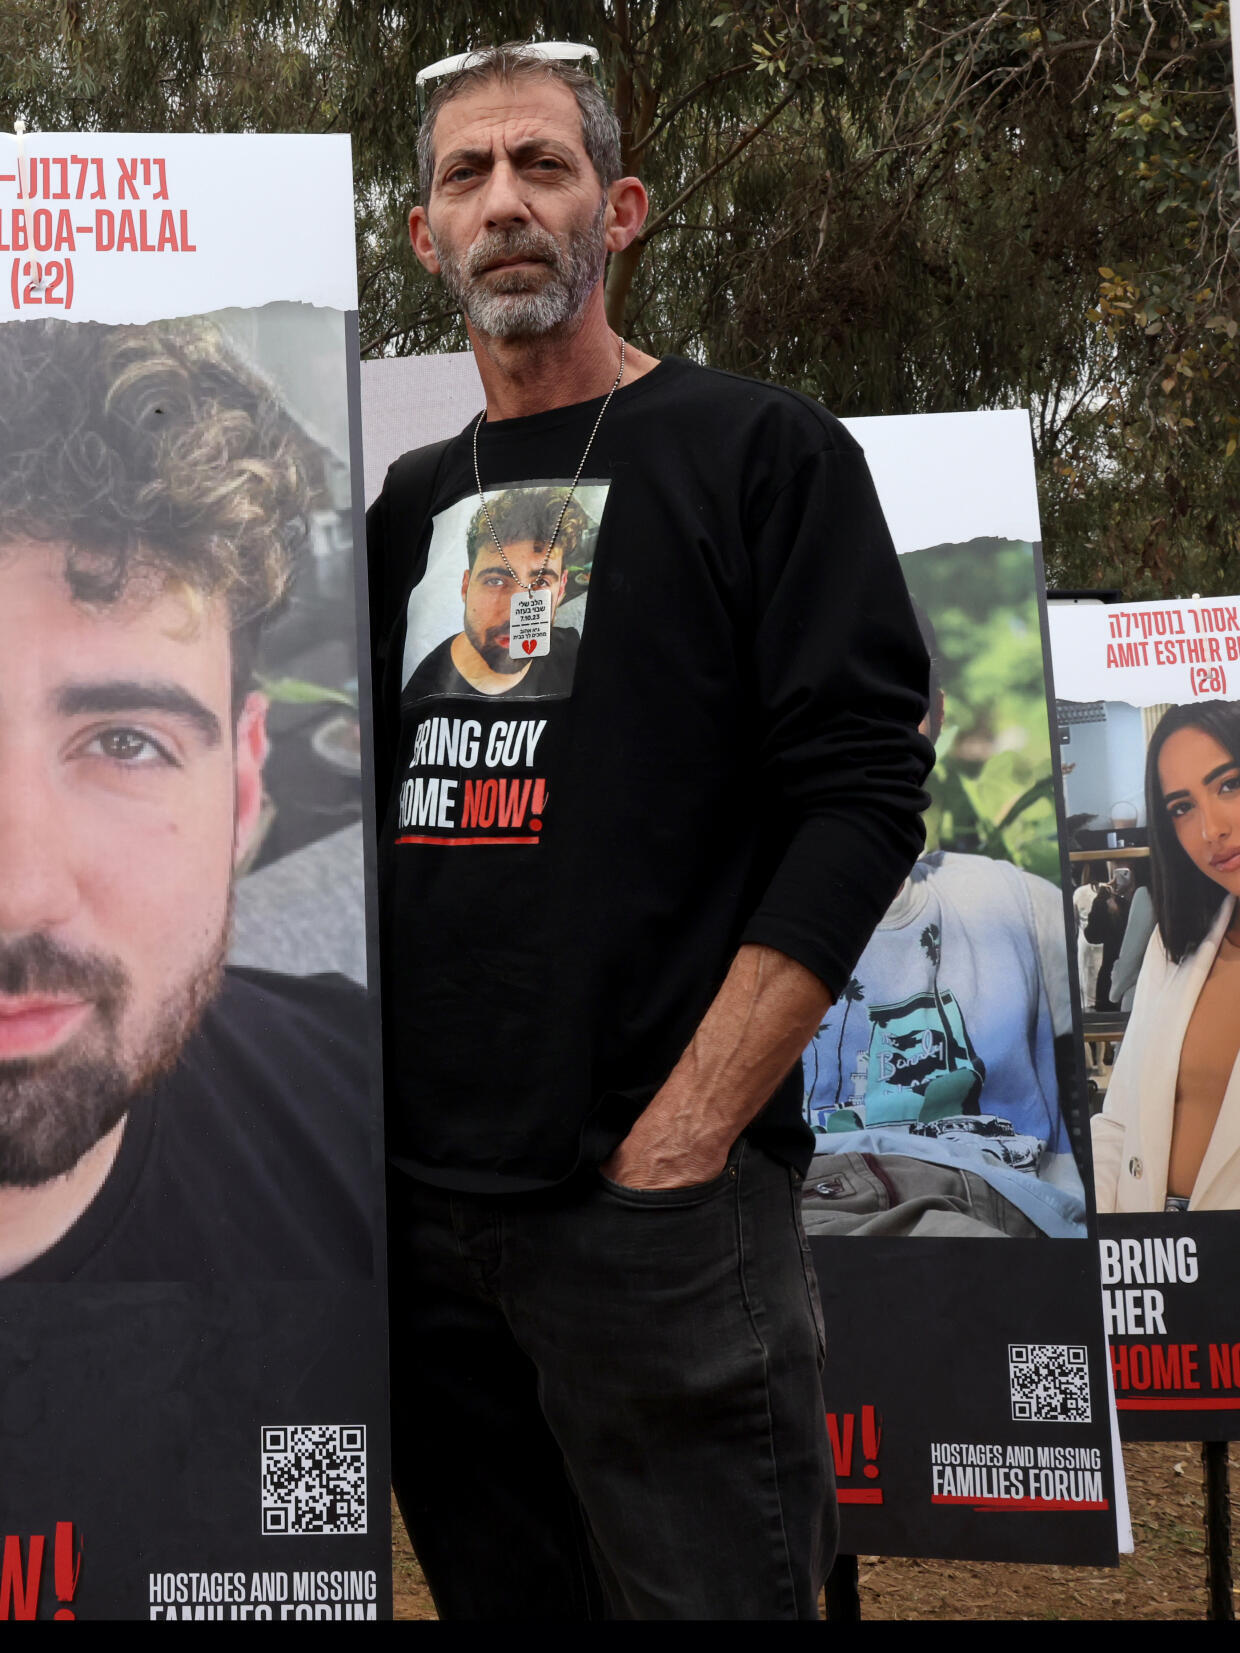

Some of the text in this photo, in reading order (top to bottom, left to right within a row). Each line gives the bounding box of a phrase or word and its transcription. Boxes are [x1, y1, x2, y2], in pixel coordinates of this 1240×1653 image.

[116, 157, 170, 200] גיא
[10, 258, 75, 309] (22)
[1108, 610, 1185, 639] בוסקילה
[1106, 641, 1149, 669] AMIT
[1225, 636, 1240, 662] B
[1190, 665, 1227, 696] (28)
[409, 717, 547, 769] BRING GUY
[398, 778, 549, 832] HOME NOW!
[1098, 1236, 1199, 1285] BRING
[1102, 1289, 1168, 1335] HER
[1109, 1344, 1201, 1390] HOME
[931, 1442, 1101, 1470] HOSTAGES AND MISSING
[932, 1465, 1104, 1503] FAMILIES FORUM
[149, 1570, 377, 1604] HOSTAGES AND MISSING
